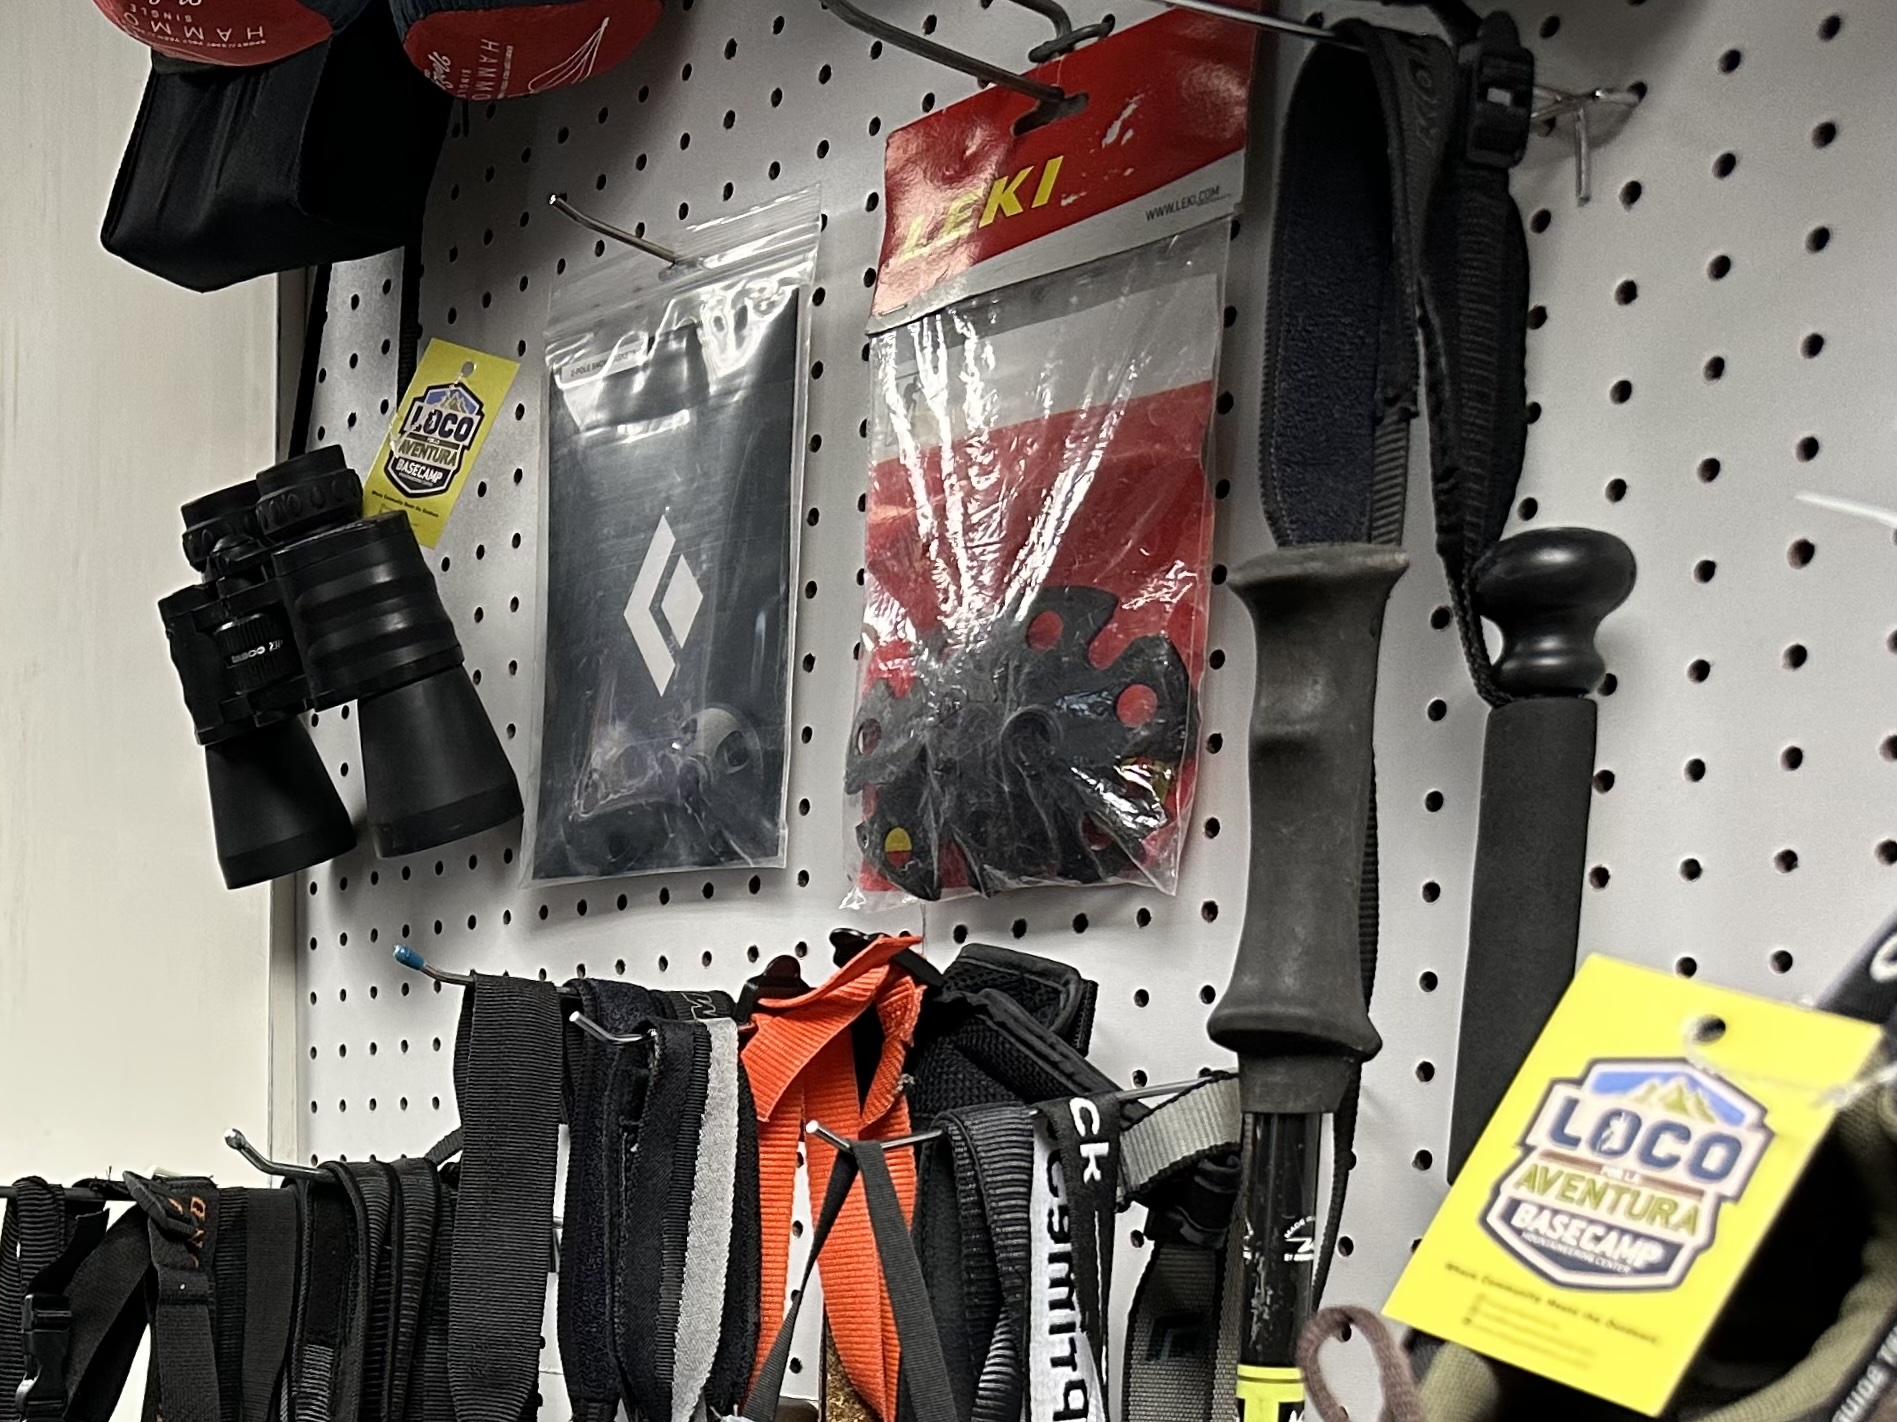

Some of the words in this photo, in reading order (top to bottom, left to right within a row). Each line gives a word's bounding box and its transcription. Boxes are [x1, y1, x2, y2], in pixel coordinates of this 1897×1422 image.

[903, 156, 1063, 260] LEKI
[1146, 185, 1221, 221] WWW.LEKI.COM
[408, 405, 479, 442] LOCO
[395, 459, 444, 485] BASECAMP
[397, 440, 458, 468] AVENTURA
[1546, 1094, 1744, 1184] LOCO
[1513, 1164, 1700, 1237] AVENTURA
[1510, 1200, 1665, 1270] BASECAMP
